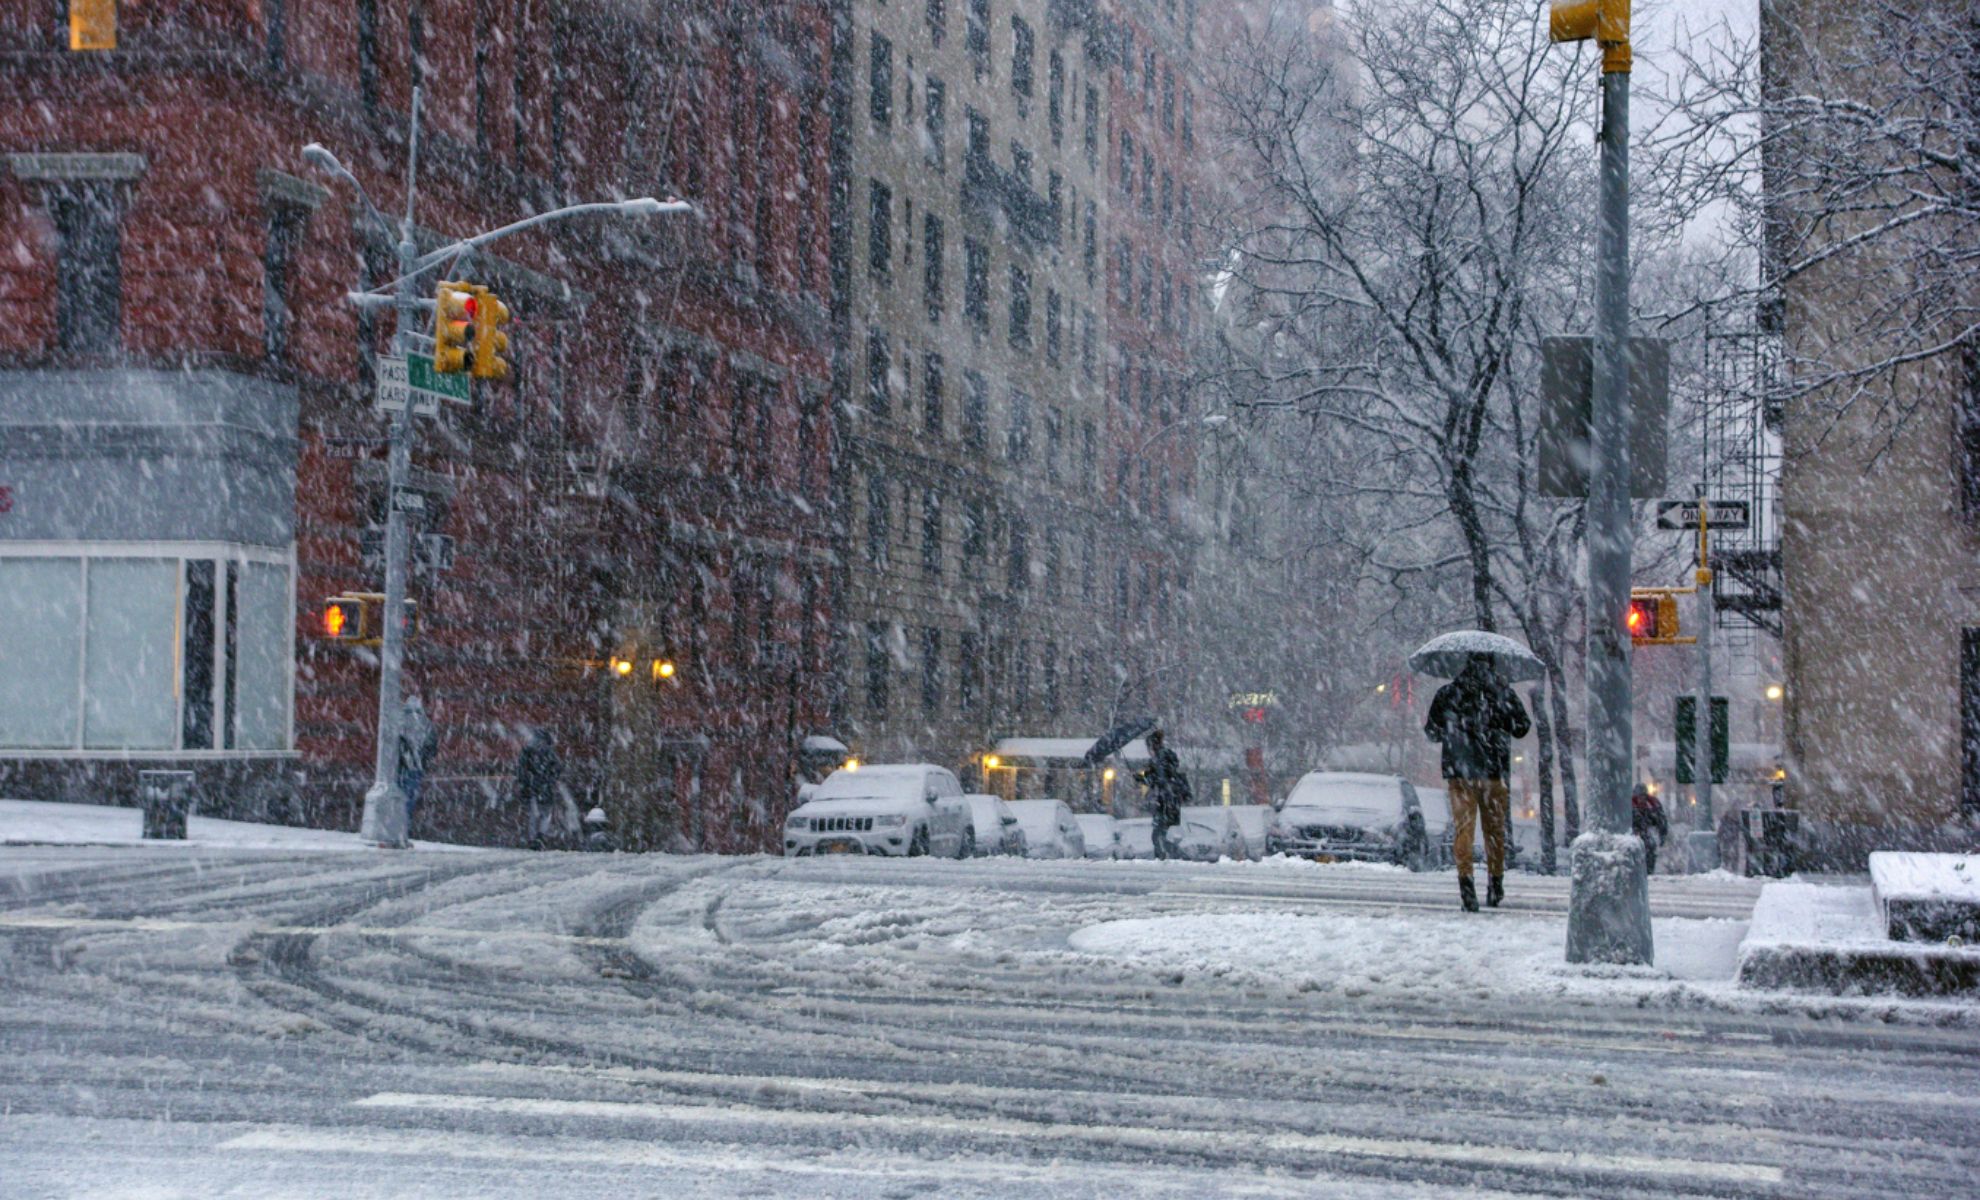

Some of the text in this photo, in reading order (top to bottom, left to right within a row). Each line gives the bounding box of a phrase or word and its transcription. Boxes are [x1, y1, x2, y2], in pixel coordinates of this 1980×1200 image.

[382, 363, 407, 382] PASS
[381, 385, 436, 407] CARS NLY
[1713, 508, 1739, 521] WAY
